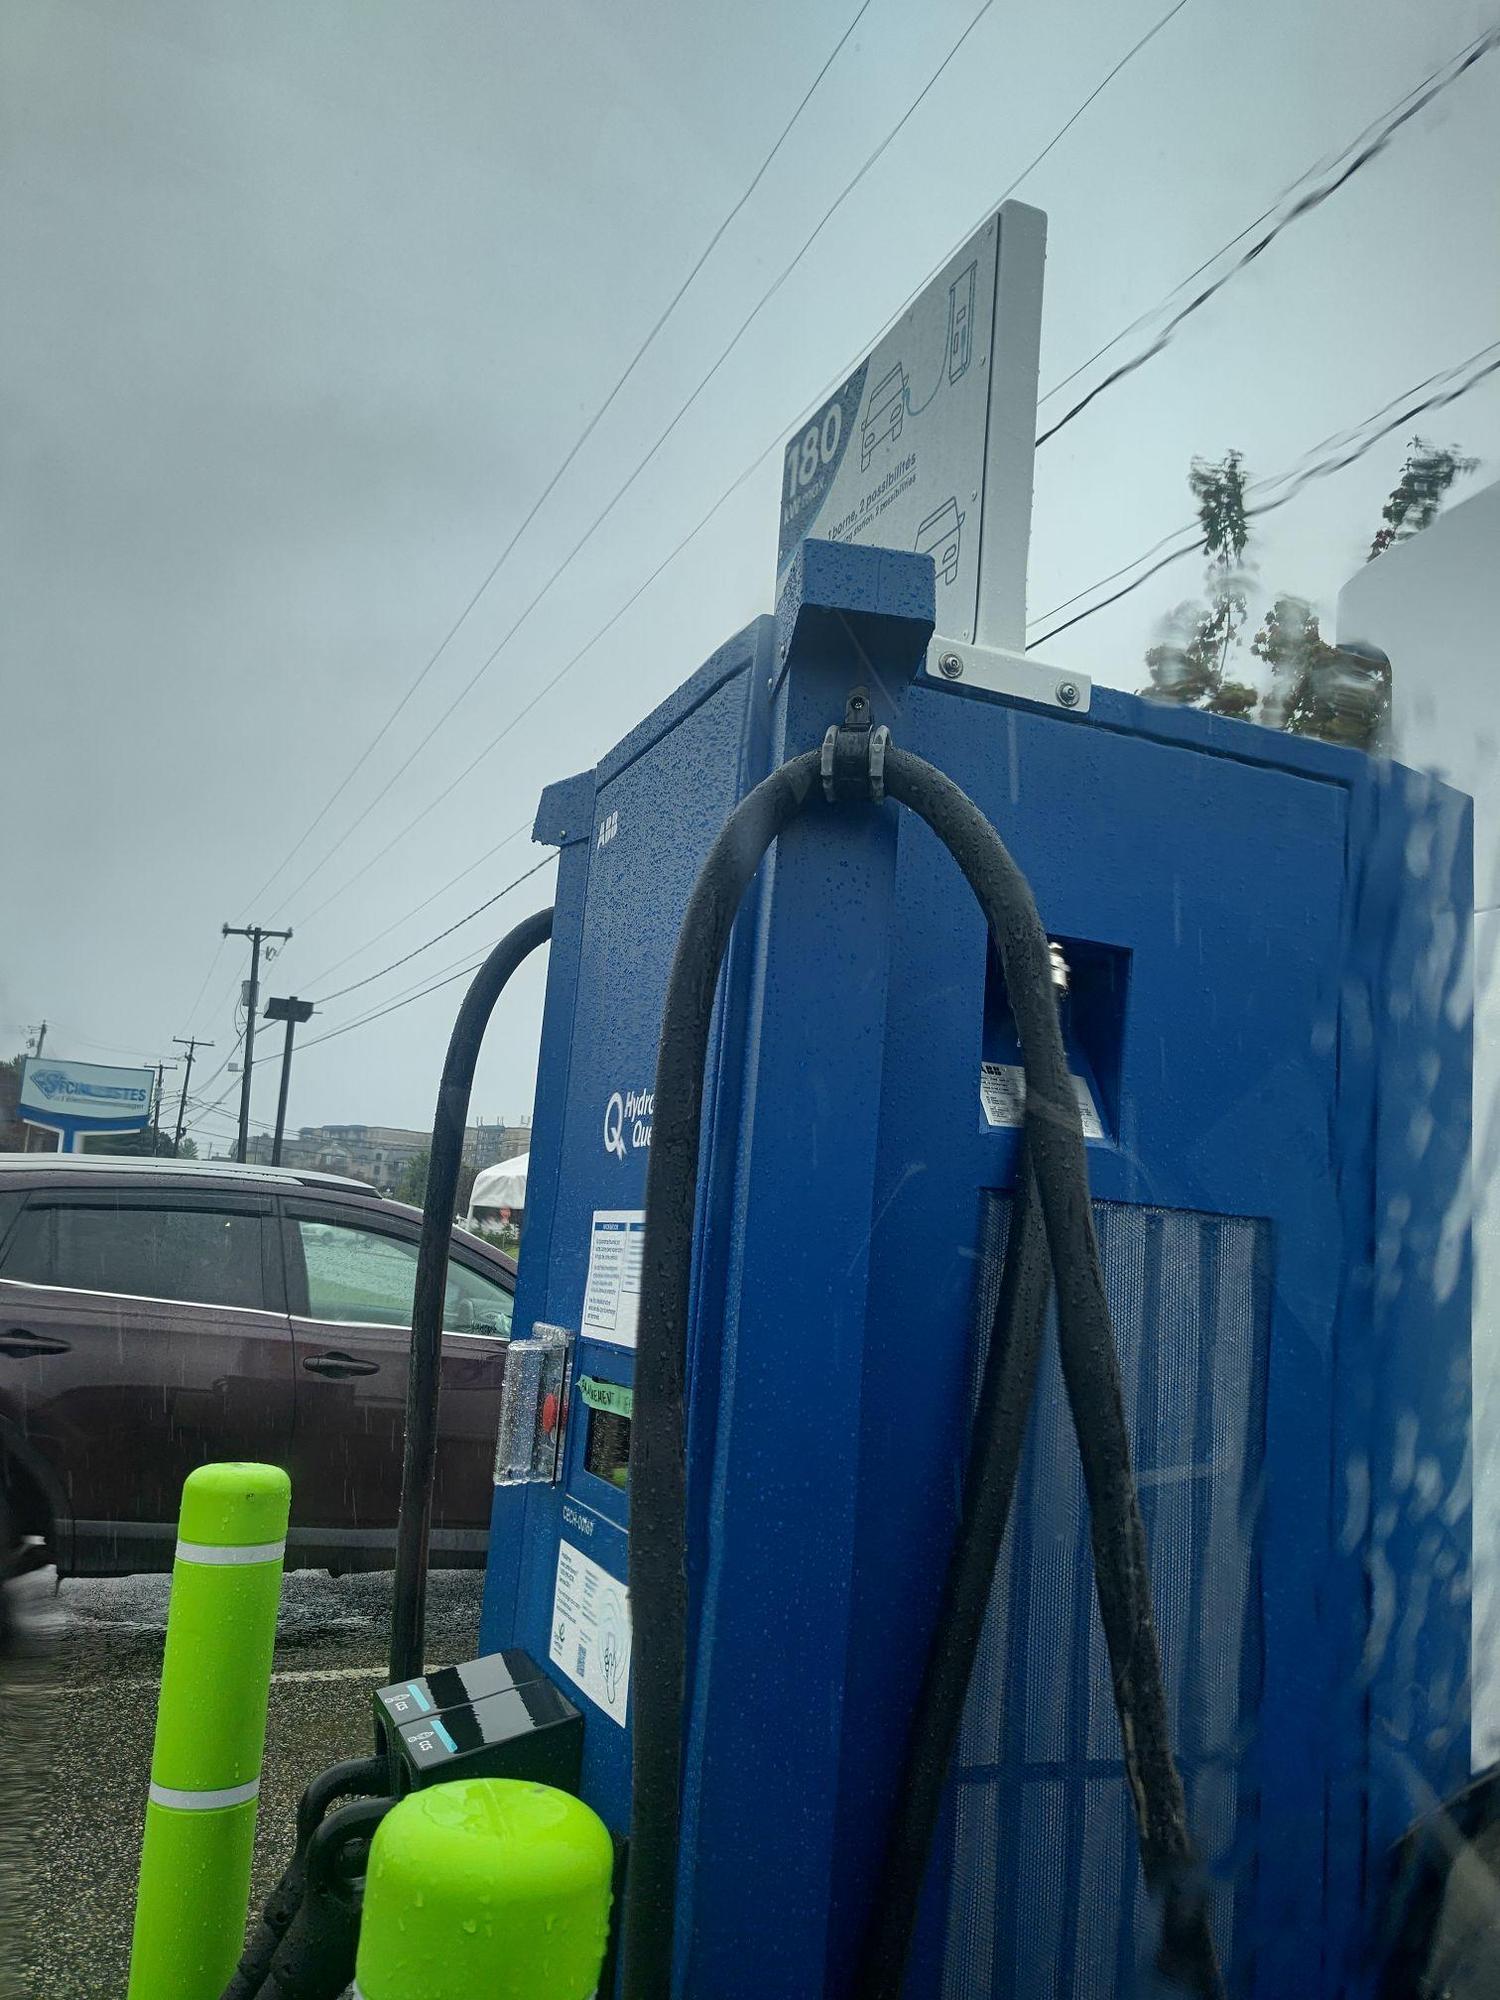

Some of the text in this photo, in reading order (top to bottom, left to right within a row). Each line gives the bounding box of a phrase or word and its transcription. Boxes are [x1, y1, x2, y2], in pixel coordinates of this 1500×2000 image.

[786, 403, 842, 499] 180
[831, 510, 858, 540] borne,
[859, 498, 866, 514] 2
[865, 452, 917, 511] possibilités
[879, 473, 917, 516] possibilities
[419, 1740, 434, 1751] CCS
